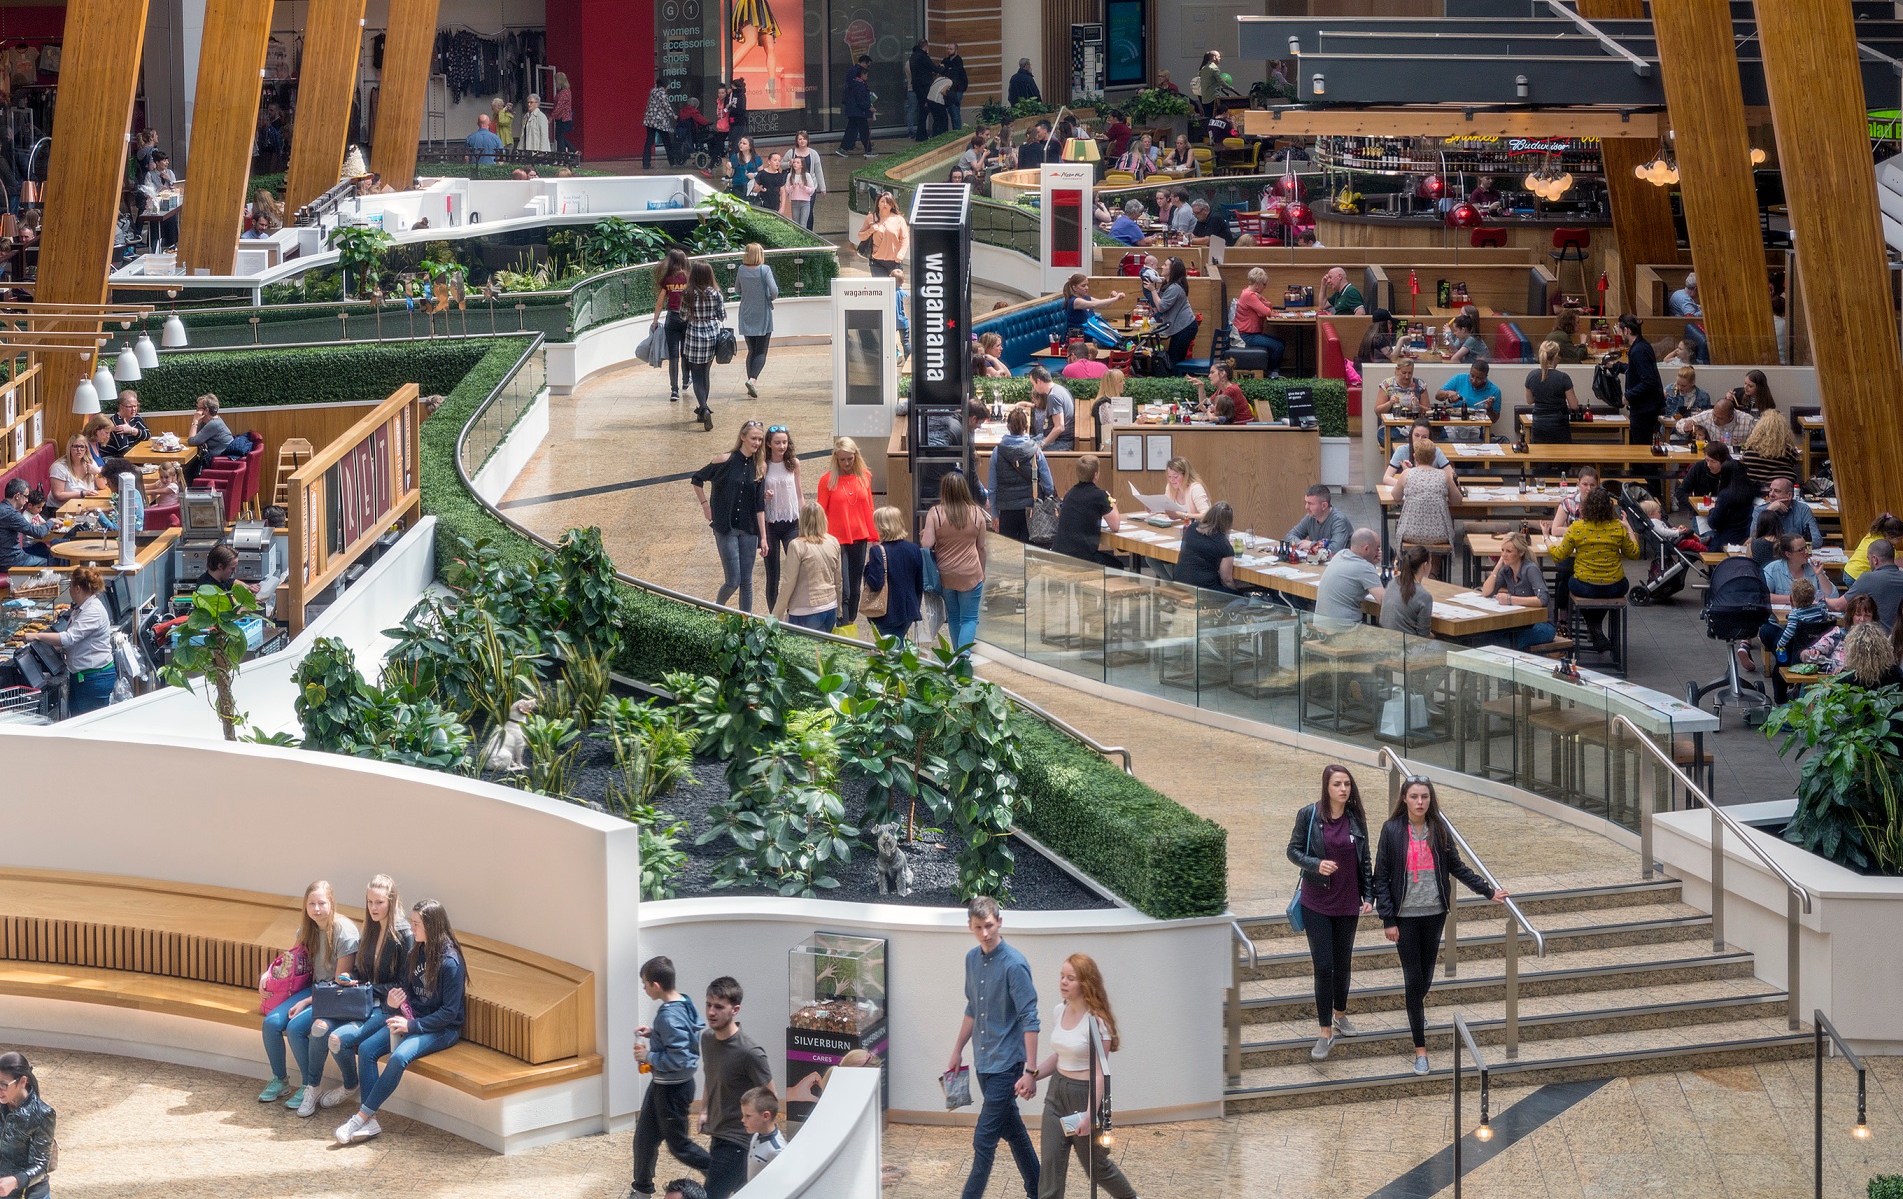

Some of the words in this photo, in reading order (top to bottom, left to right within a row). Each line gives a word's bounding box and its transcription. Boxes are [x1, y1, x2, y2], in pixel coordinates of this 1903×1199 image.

[666, 6, 674, 16] G
[662, 26, 700, 36] womens
[662, 38, 716, 50] accessories
[662, 53, 690, 63] shoes
[662, 67, 688, 77] mens
[668, 93, 688, 103] ome
[748, 115, 767, 125] PICK
[768, 114, 779, 123] UP
[748, 124, 756, 133] IN
[757, 123, 779, 133] STORE
[1509, 139, 1570, 150] Budweiser
[843, 289, 883, 298] wagamama
[921, 252, 945, 382] wagamama
[794, 1035, 851, 1051] SILVERBURN
[812, 1054, 832, 1063] CARES
